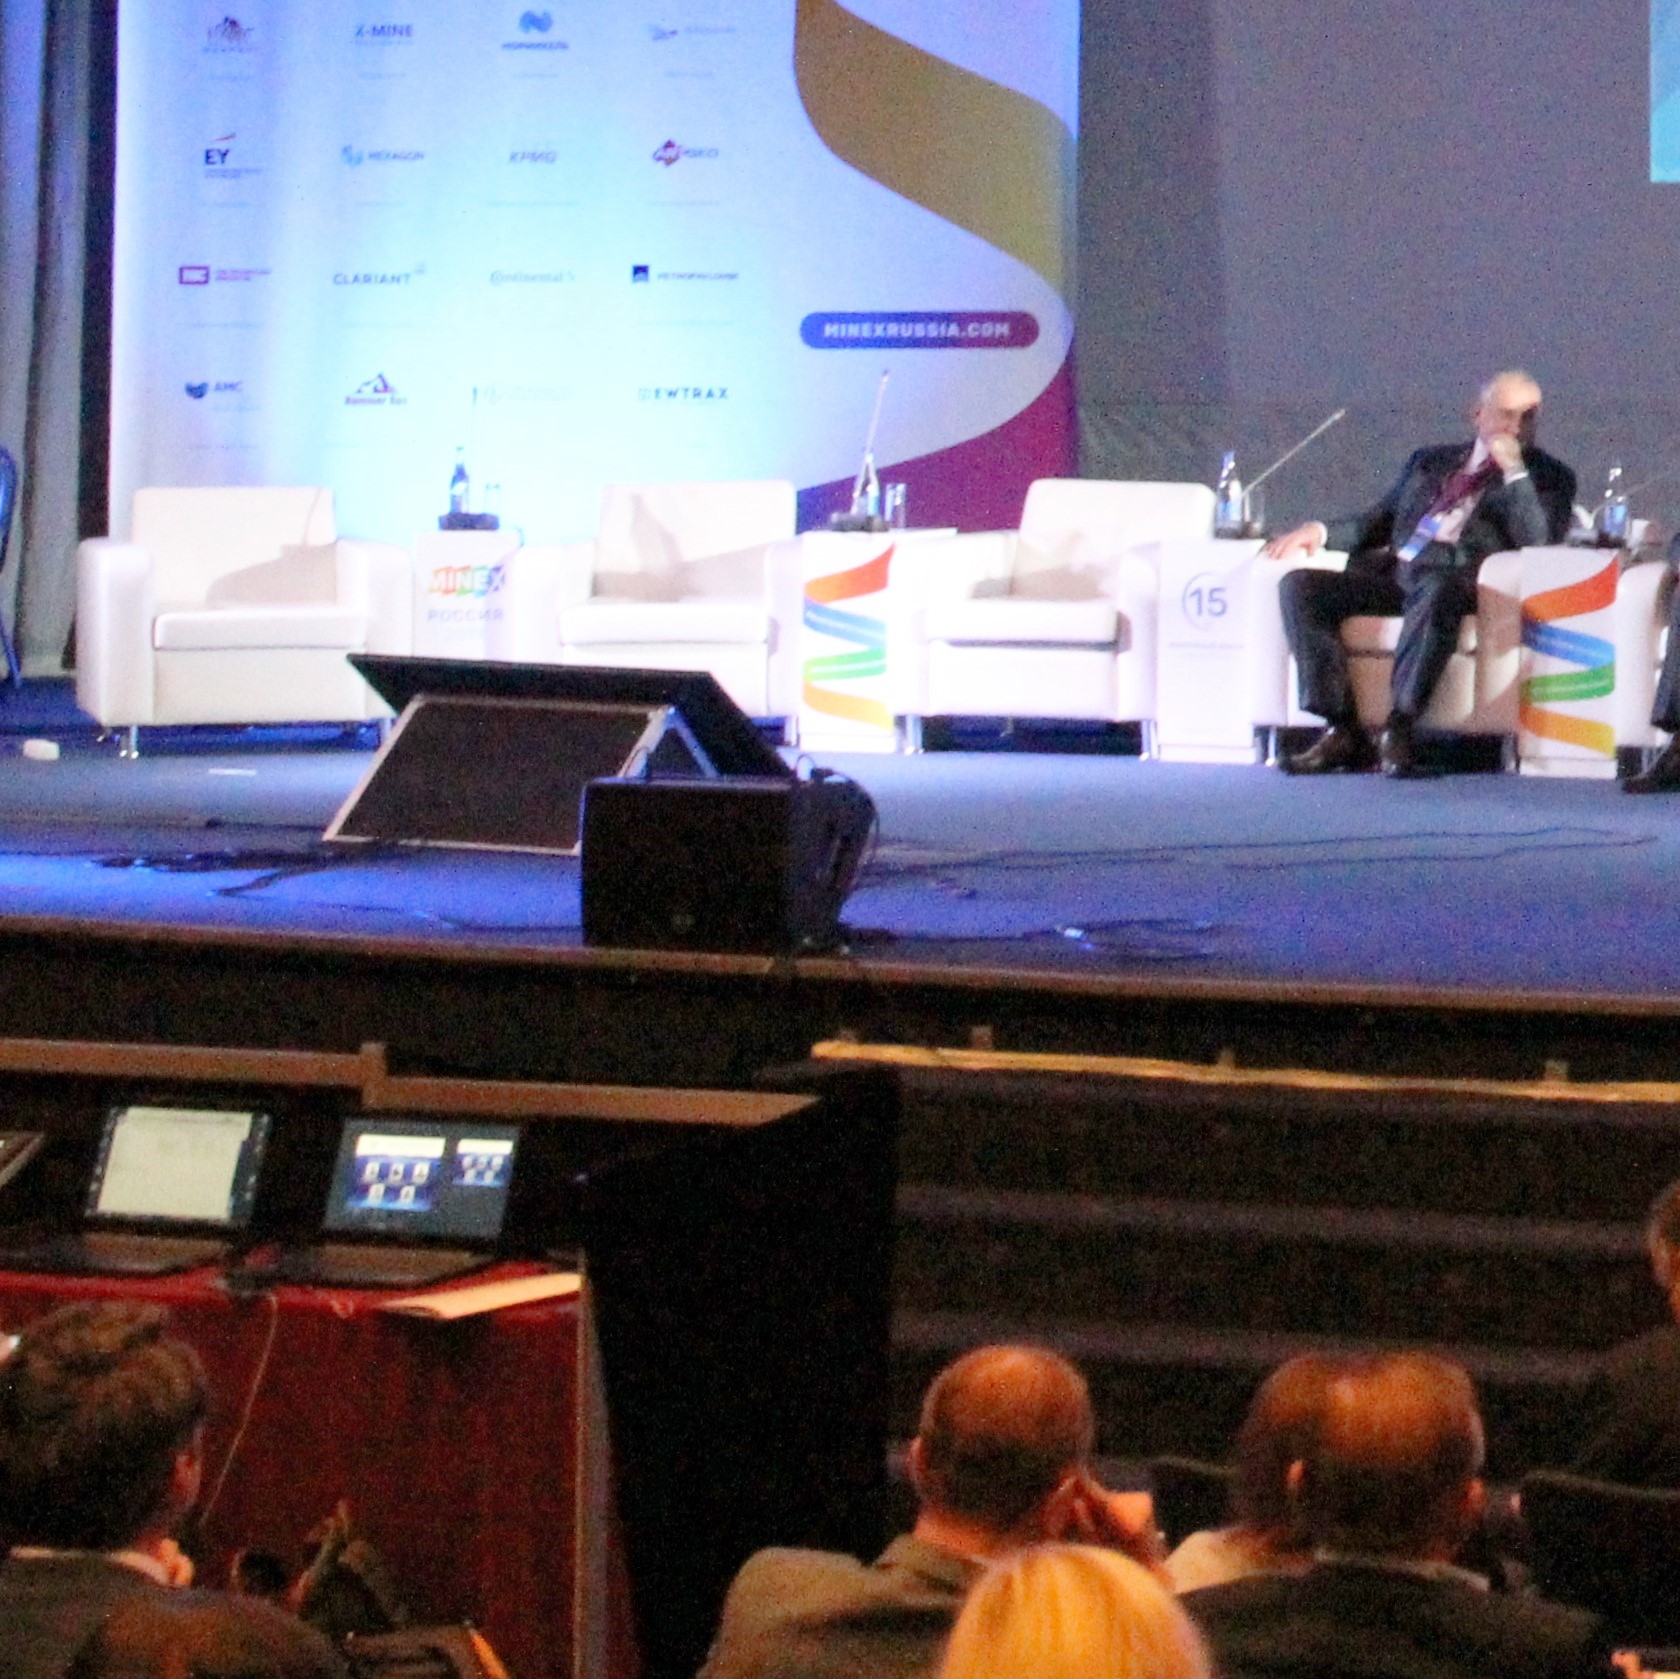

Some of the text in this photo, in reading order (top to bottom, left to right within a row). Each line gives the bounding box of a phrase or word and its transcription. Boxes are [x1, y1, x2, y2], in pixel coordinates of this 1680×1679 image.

[204, 148, 231, 166] EY
[823, 322, 1010, 338] MINEXRUSSIA.COM
[426, 564, 508, 597] MINEX
[1189, 585, 1229, 618] 15
